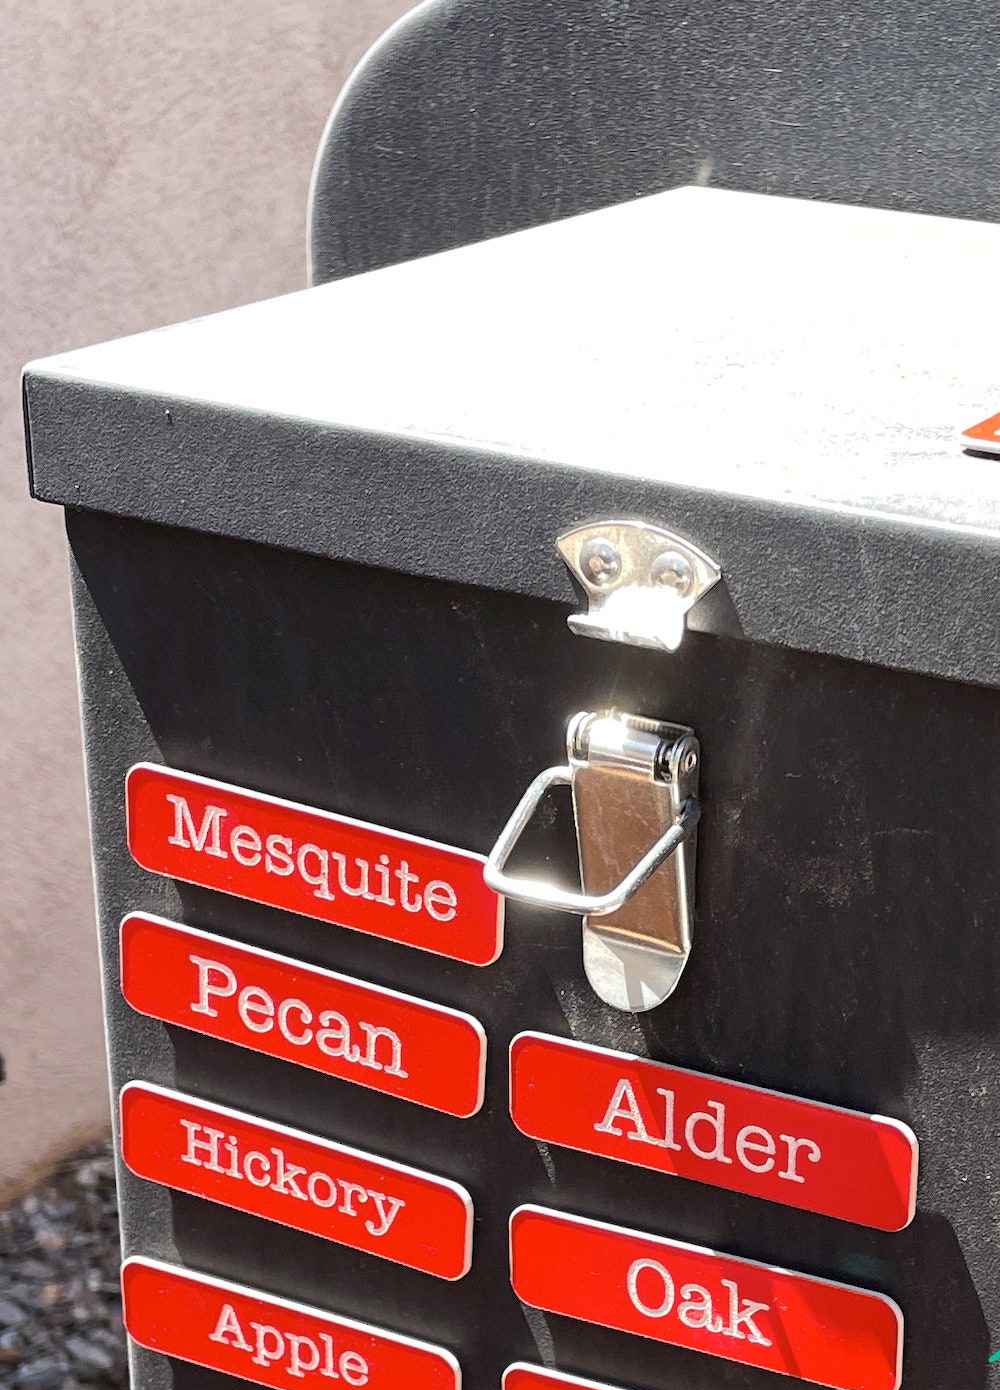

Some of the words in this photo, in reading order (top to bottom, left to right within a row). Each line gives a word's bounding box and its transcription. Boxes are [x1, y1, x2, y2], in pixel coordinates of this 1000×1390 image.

[166, 794, 458, 922] Mesquite
[189, 954, 409, 1079] Pecan
[180, 1119, 406, 1236] Hickory
[593, 1078, 822, 1184] Alder
[208, 1304, 370, 1387] Apple
[626, 1258, 773, 1347] Oak
